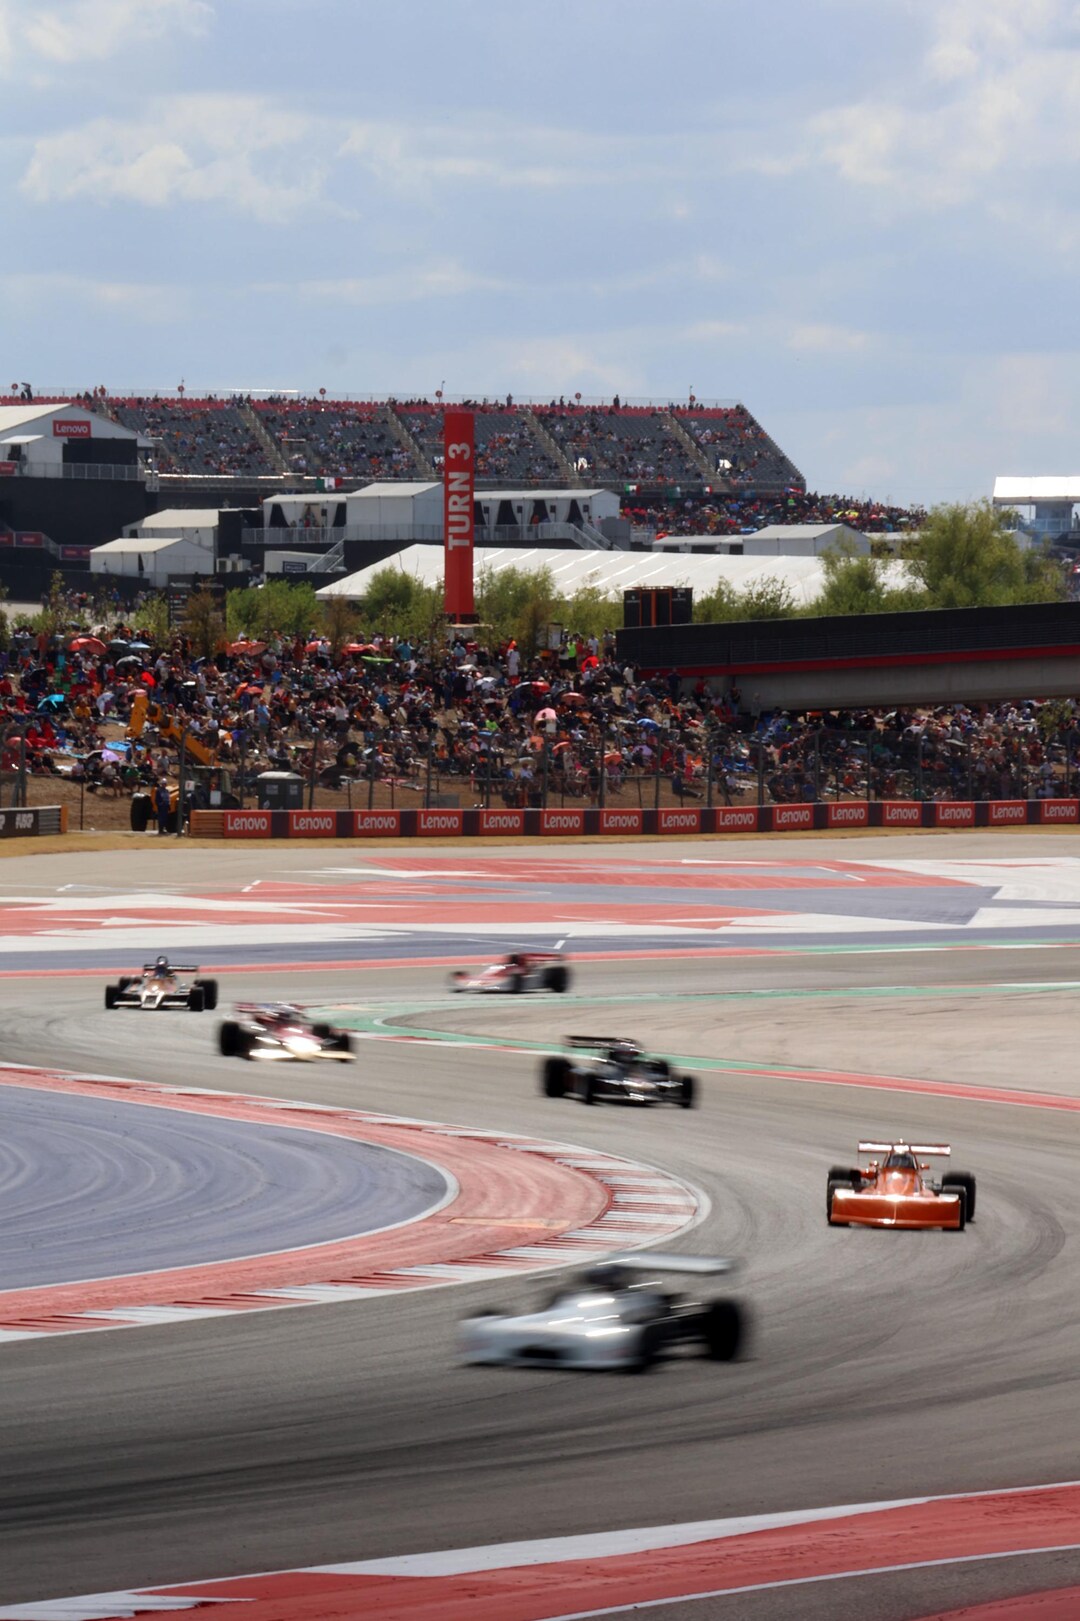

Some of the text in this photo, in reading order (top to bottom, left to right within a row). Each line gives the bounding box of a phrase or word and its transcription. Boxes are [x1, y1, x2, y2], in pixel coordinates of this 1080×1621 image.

[56, 423, 88, 434] Lenovo
[448, 442, 471, 551] TURN 3
[776, 808, 810, 823] Lenovo
[832, 806, 865, 821] Lenovo
[886, 805, 919, 820] Lenovo
[939, 805, 972, 819] Lenovo
[992, 805, 1024, 819] Lenovo
[1044, 803, 1076, 817] Lenovo
[228, 814, 268, 831] Lenovo
[293, 814, 332, 830] Lenovo
[358, 814, 396, 829] Lenovo
[421, 814, 459, 829] Lenovo
[483, 813, 520, 828] Lenovo
[544, 813, 581, 828] Lenovo
[603, 813, 639, 828] Lenovo
[661, 812, 697, 828] Lenovo
[720, 811, 755, 826] Lenovo
